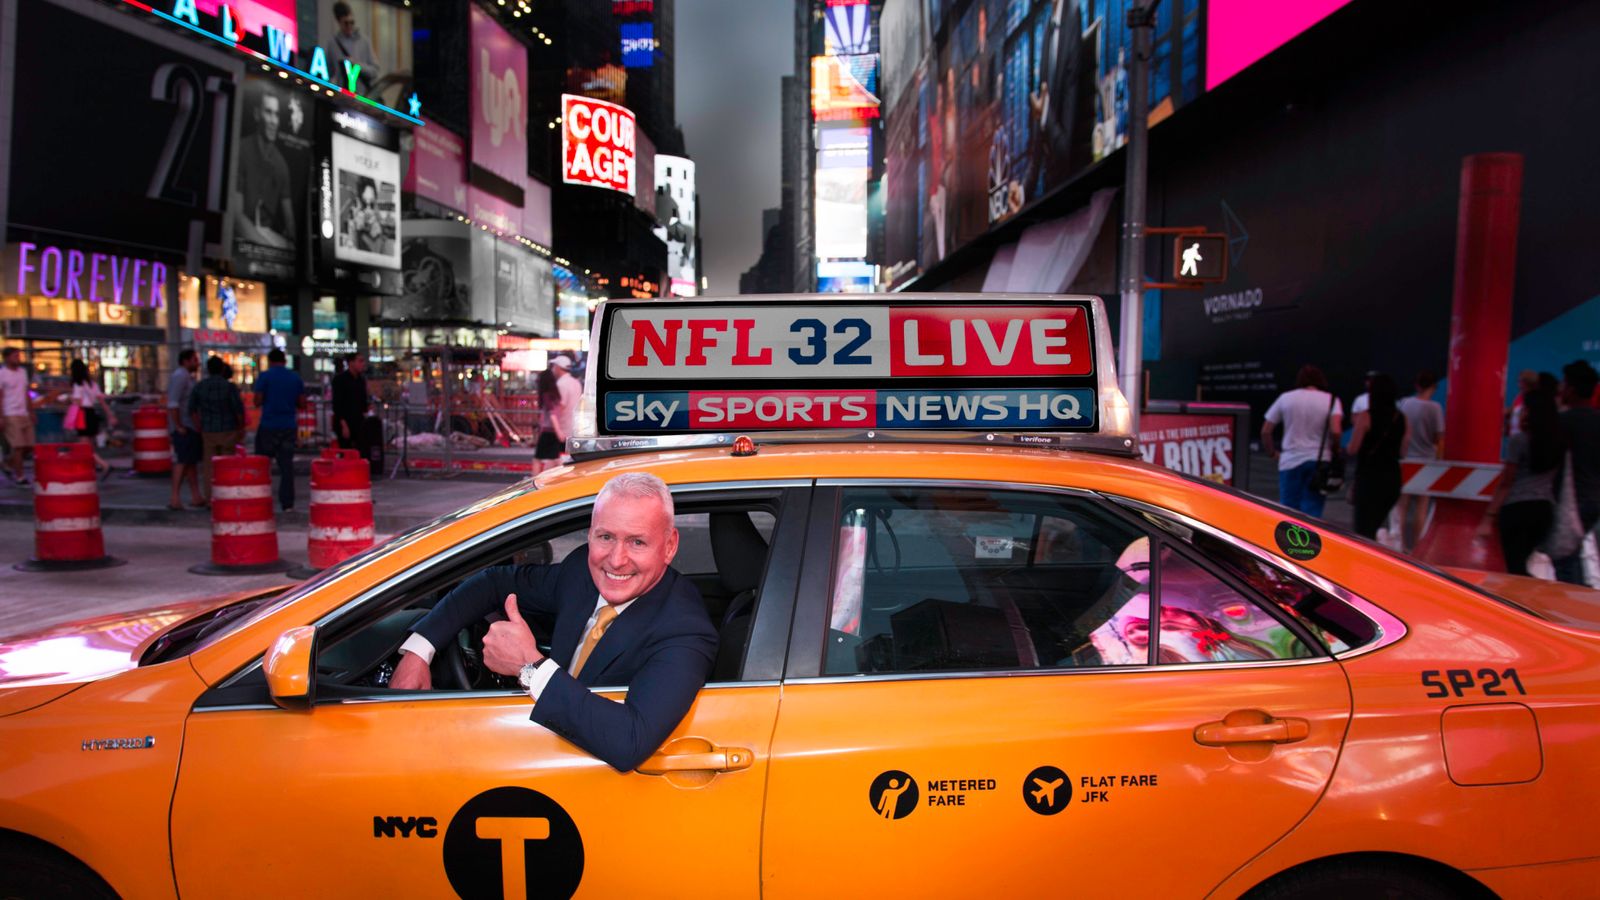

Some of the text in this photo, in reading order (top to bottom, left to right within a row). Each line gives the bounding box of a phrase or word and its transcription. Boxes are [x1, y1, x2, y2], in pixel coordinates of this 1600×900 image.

[146, 63, 236, 213] 21
[17, 241, 167, 308] FOREVER
[1203, 288, 1263, 315] VORNADO
[627, 318, 1072, 367] NFL 32 LIVE
[614, 394, 1083, 428] sky SPORTS NEWS HQ
[928, 779, 996, 792] METERED
[1081, 775, 1158, 788] FLAT FARE
[928, 795, 965, 806] FARE
[1081, 792, 1109, 803] JFK
[373, 816, 437, 838] NYC
[475, 816, 550, 900] T
